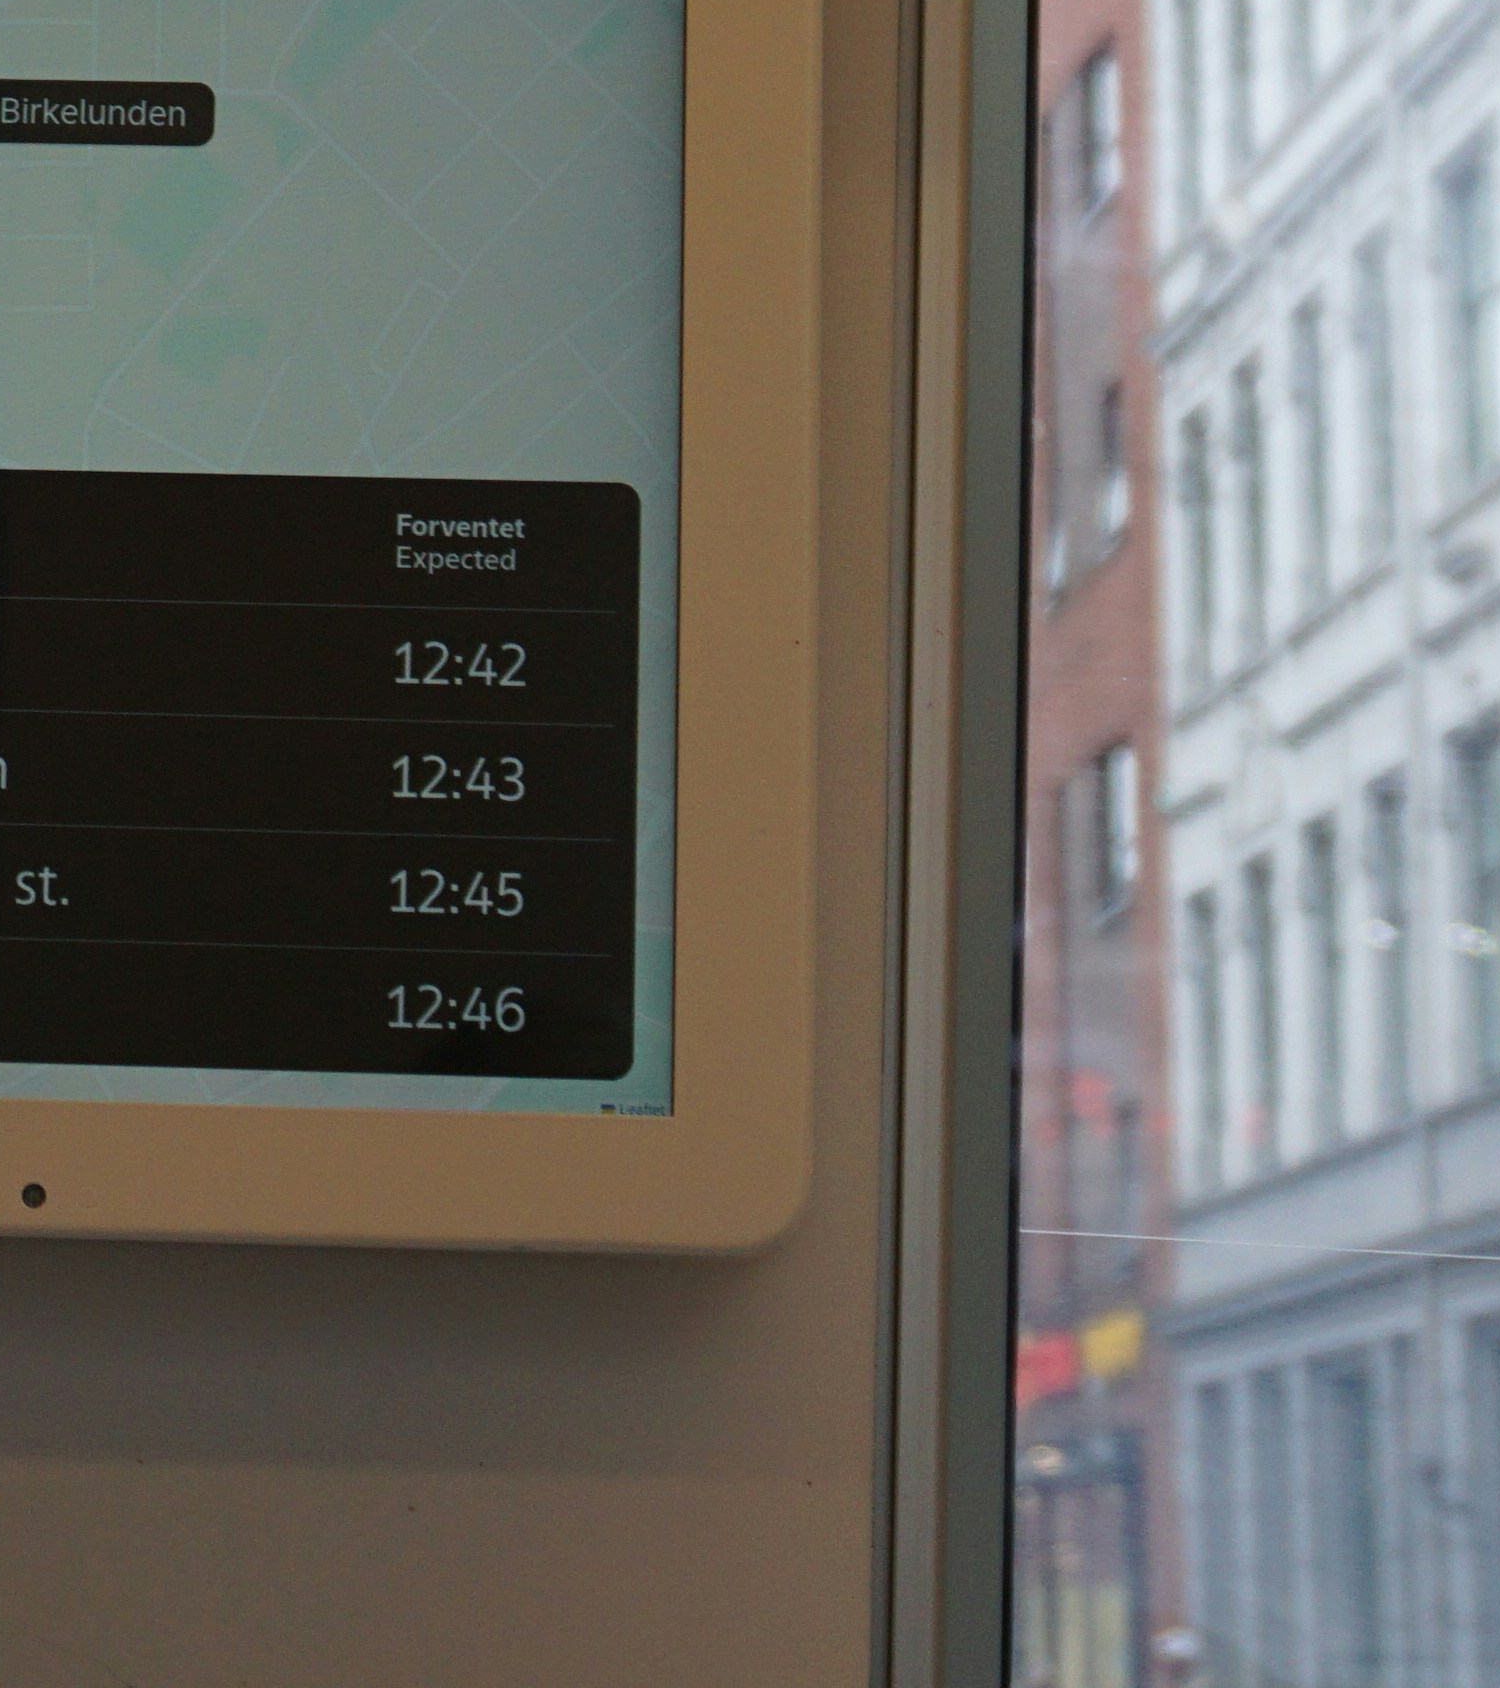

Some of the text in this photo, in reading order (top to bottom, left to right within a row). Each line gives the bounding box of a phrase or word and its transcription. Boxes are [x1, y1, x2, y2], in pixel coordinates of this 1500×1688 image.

[0, 97, 186, 127] Birkelunden
[396, 513, 525, 539] Forventet
[396, 545, 516, 575] Expected
[395, 640, 526, 687] 12:42
[393, 754, 525, 802] 12:43
[15, 866, 69, 906] st.
[390, 869, 524, 917] 12:45
[388, 984, 525, 1033] 12:46
